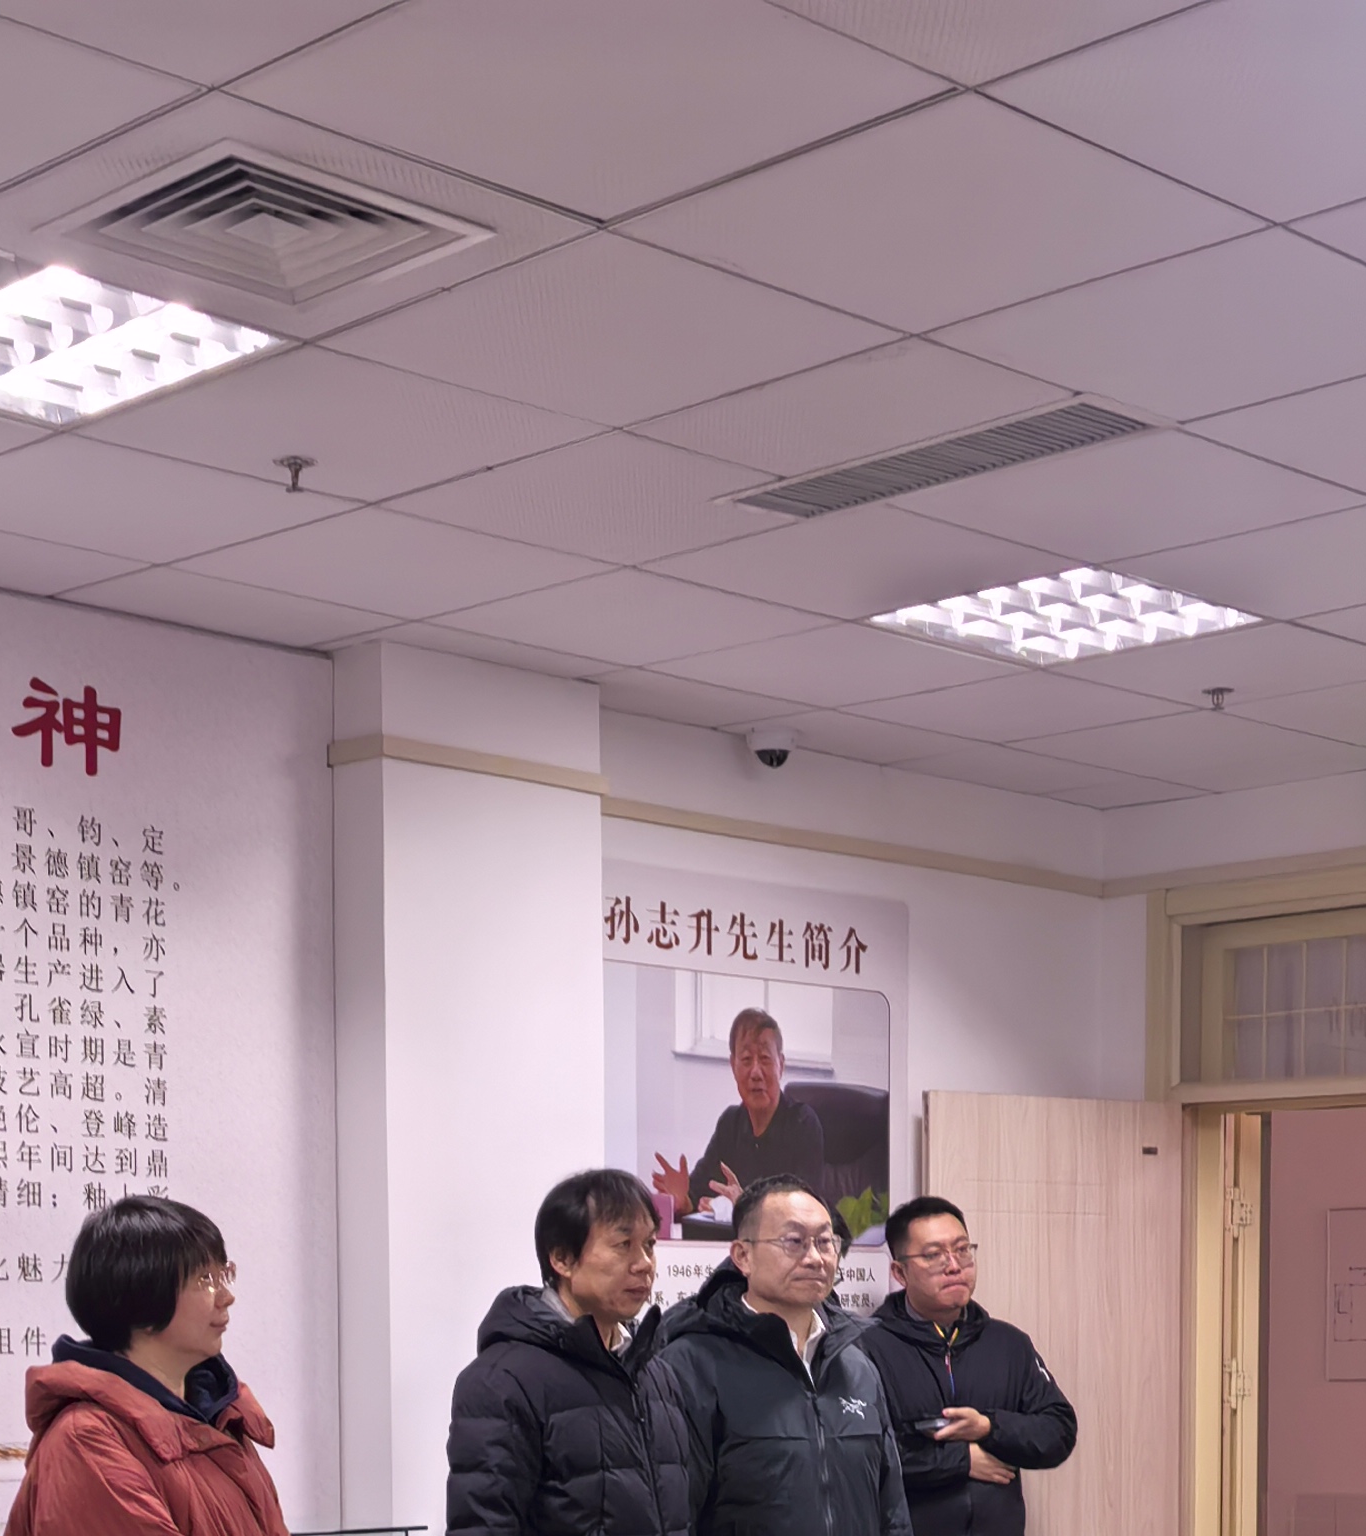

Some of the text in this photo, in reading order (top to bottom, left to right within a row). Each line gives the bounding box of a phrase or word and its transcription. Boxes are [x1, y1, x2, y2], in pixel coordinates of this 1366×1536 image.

[603, 896, 869, 975] 孙志升先生简介
